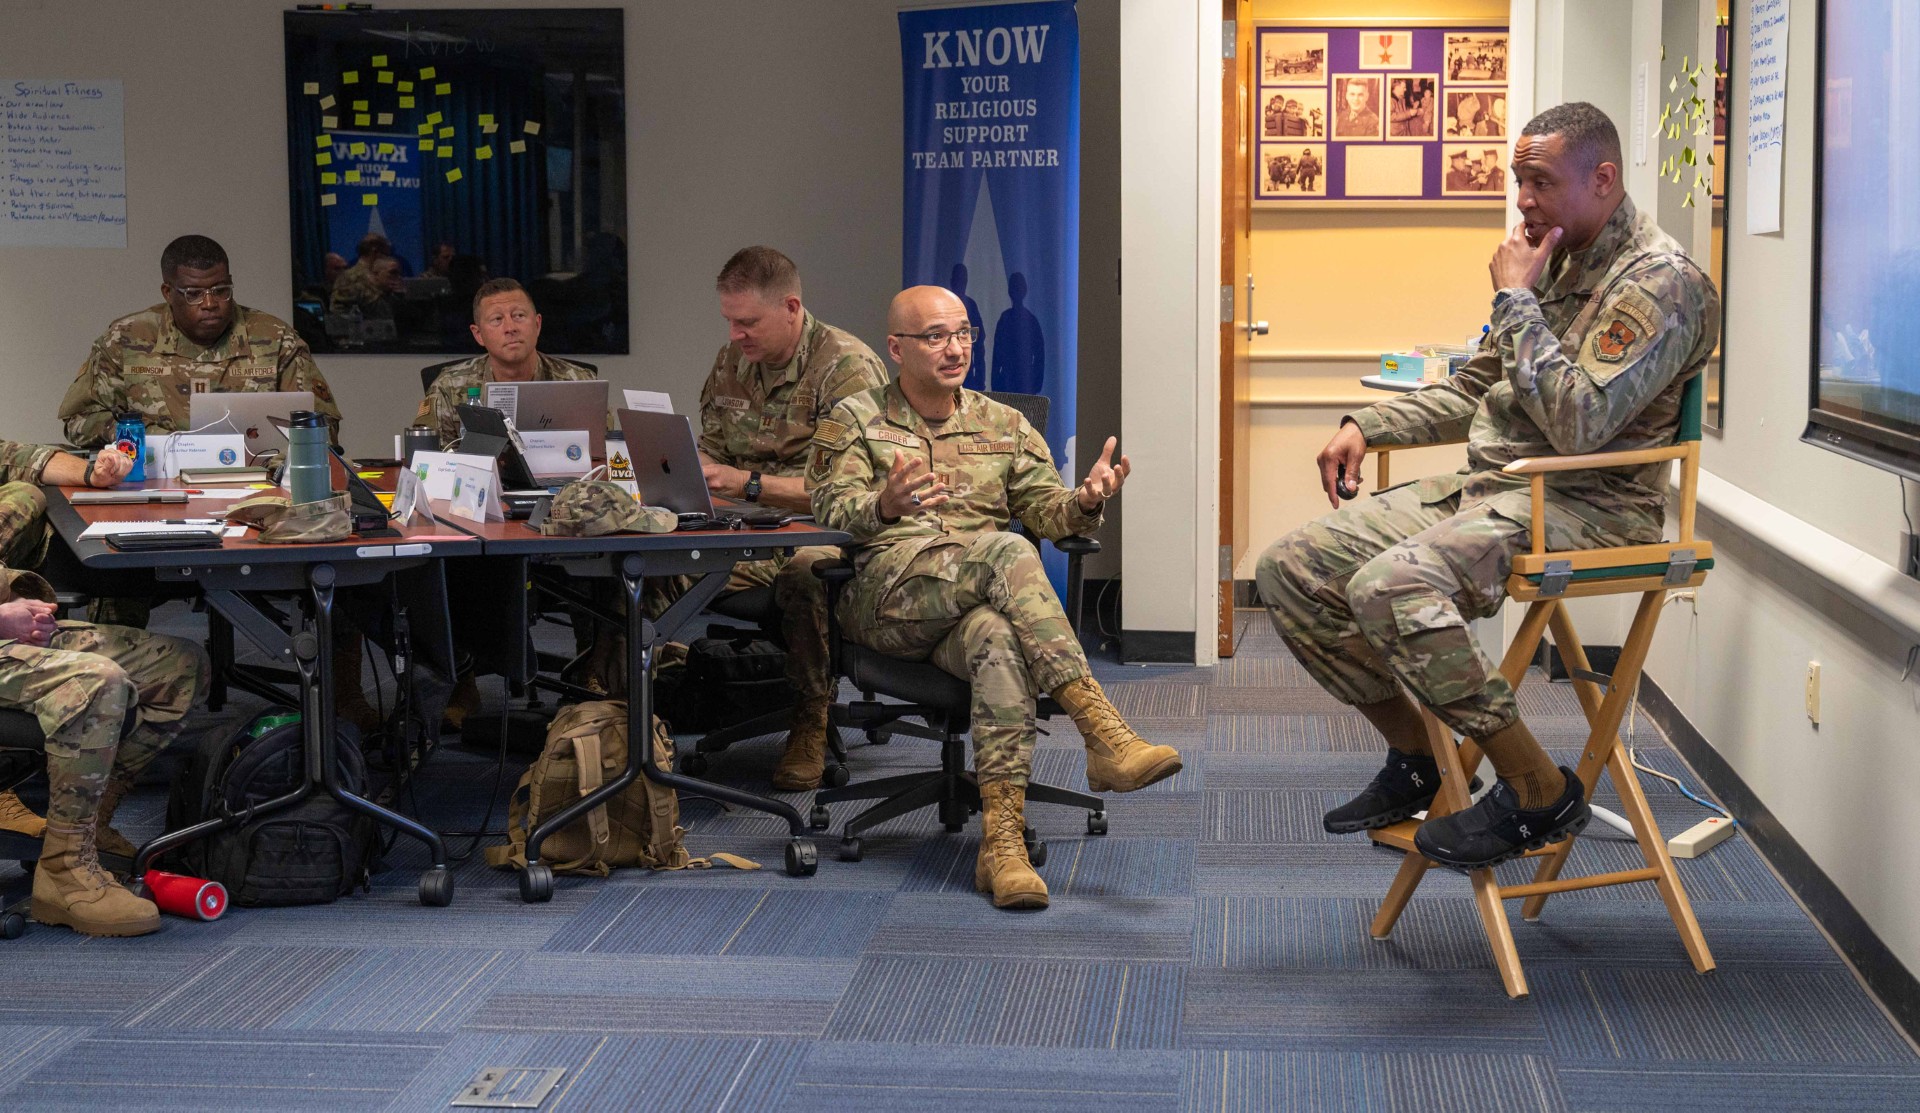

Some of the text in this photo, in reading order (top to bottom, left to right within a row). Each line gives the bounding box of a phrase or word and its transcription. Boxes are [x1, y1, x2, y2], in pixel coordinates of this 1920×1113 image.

[923, 25, 1049, 69] KNOW
[15, 82, 103, 99] Spiritual Fitness
[961, 75, 1010, 94] YOUR
[935, 99, 1037, 119] RELIGIOUS
[943, 125, 1029, 144] SUPPORT
[912, 149, 1060, 169] TEAM PARTNER
[1619, 302, 1655, 335] INSTRUCTOR
[131, 366, 164, 374] ROBINSON
[254, 366, 274, 375] FORCE
[878, 431, 908, 445] CRIDER
[976, 444, 988, 452] AIR
[990, 443, 1013, 451] FORCE
